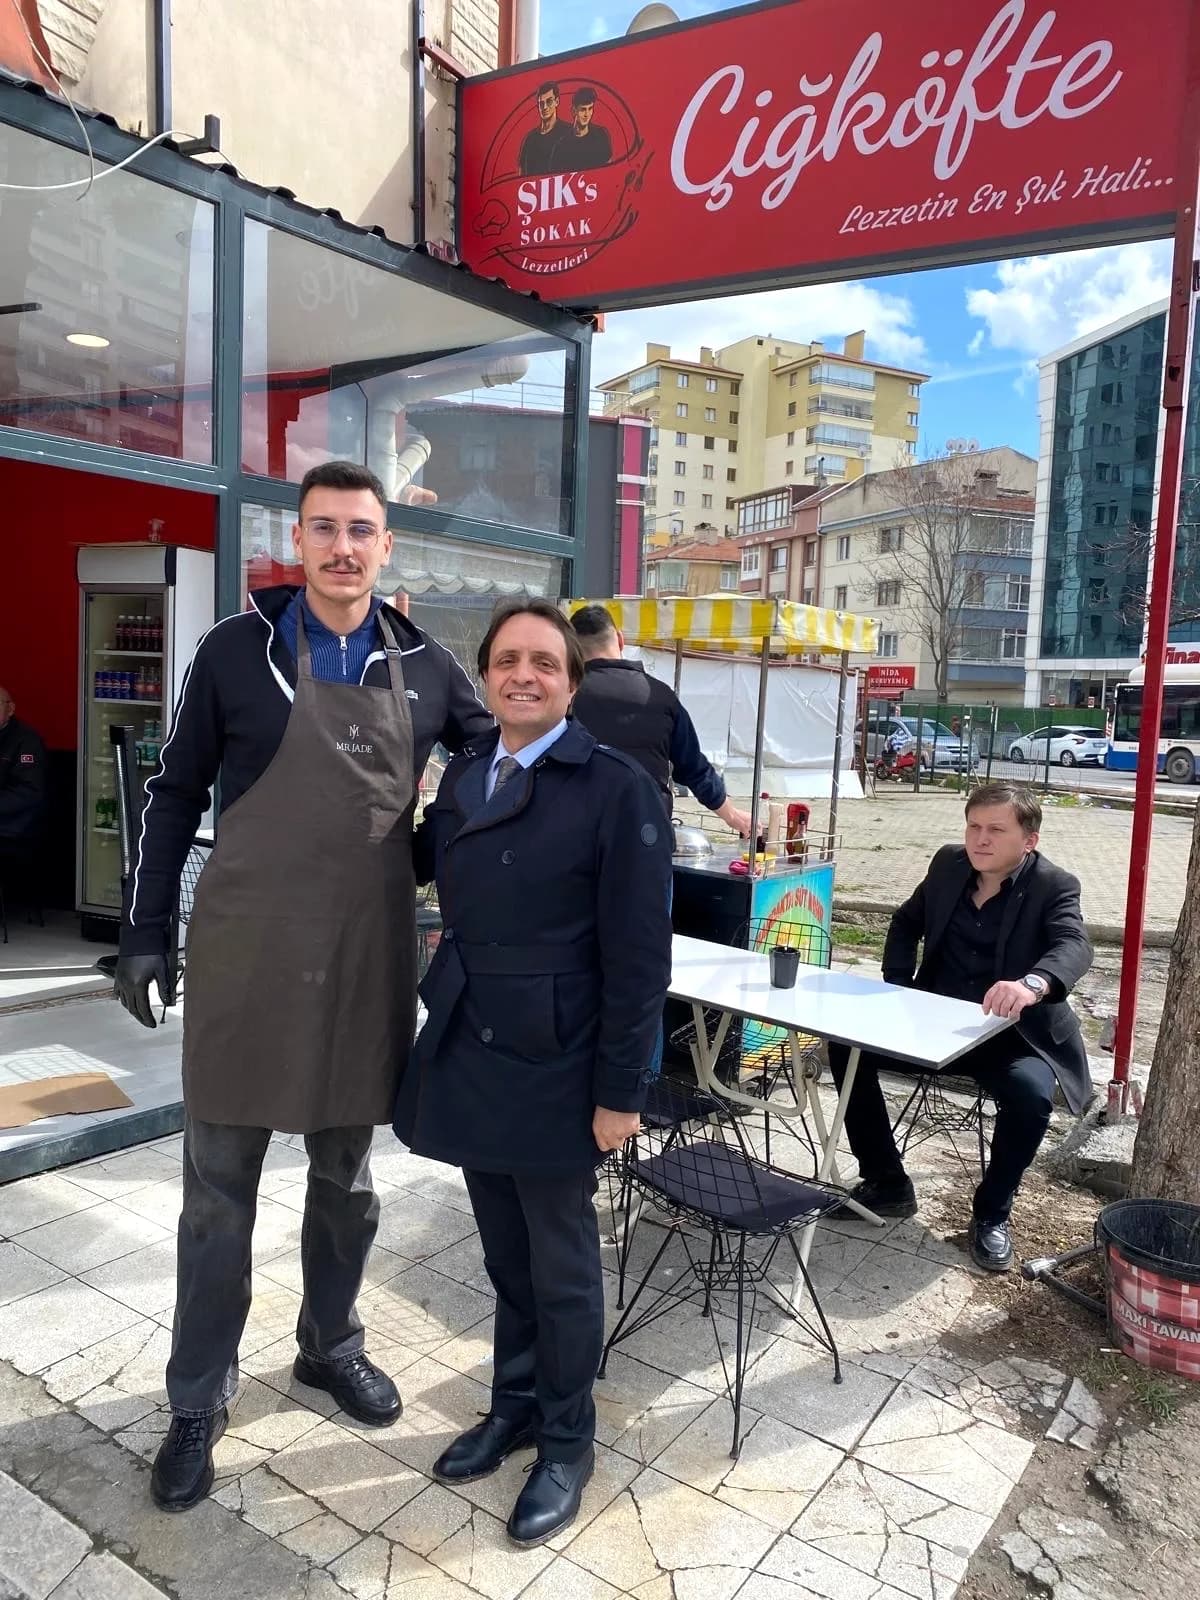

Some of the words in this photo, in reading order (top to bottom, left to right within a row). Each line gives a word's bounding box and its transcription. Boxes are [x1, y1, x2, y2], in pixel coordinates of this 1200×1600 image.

[671, 0, 1123, 211] Çiğköfte
[839, 192, 959, 234] Lezzetin
[968, 184, 1007, 214] En
[1014, 170, 1067, 215] Şık
[1071, 157, 1173, 199] Hali...
[520, 219, 592, 246] SOKAK
[521, 248, 588, 273] Lezzetleri
[880, 668, 900, 676] NİDA
[1114, 1300, 1147, 1328] MAXI
